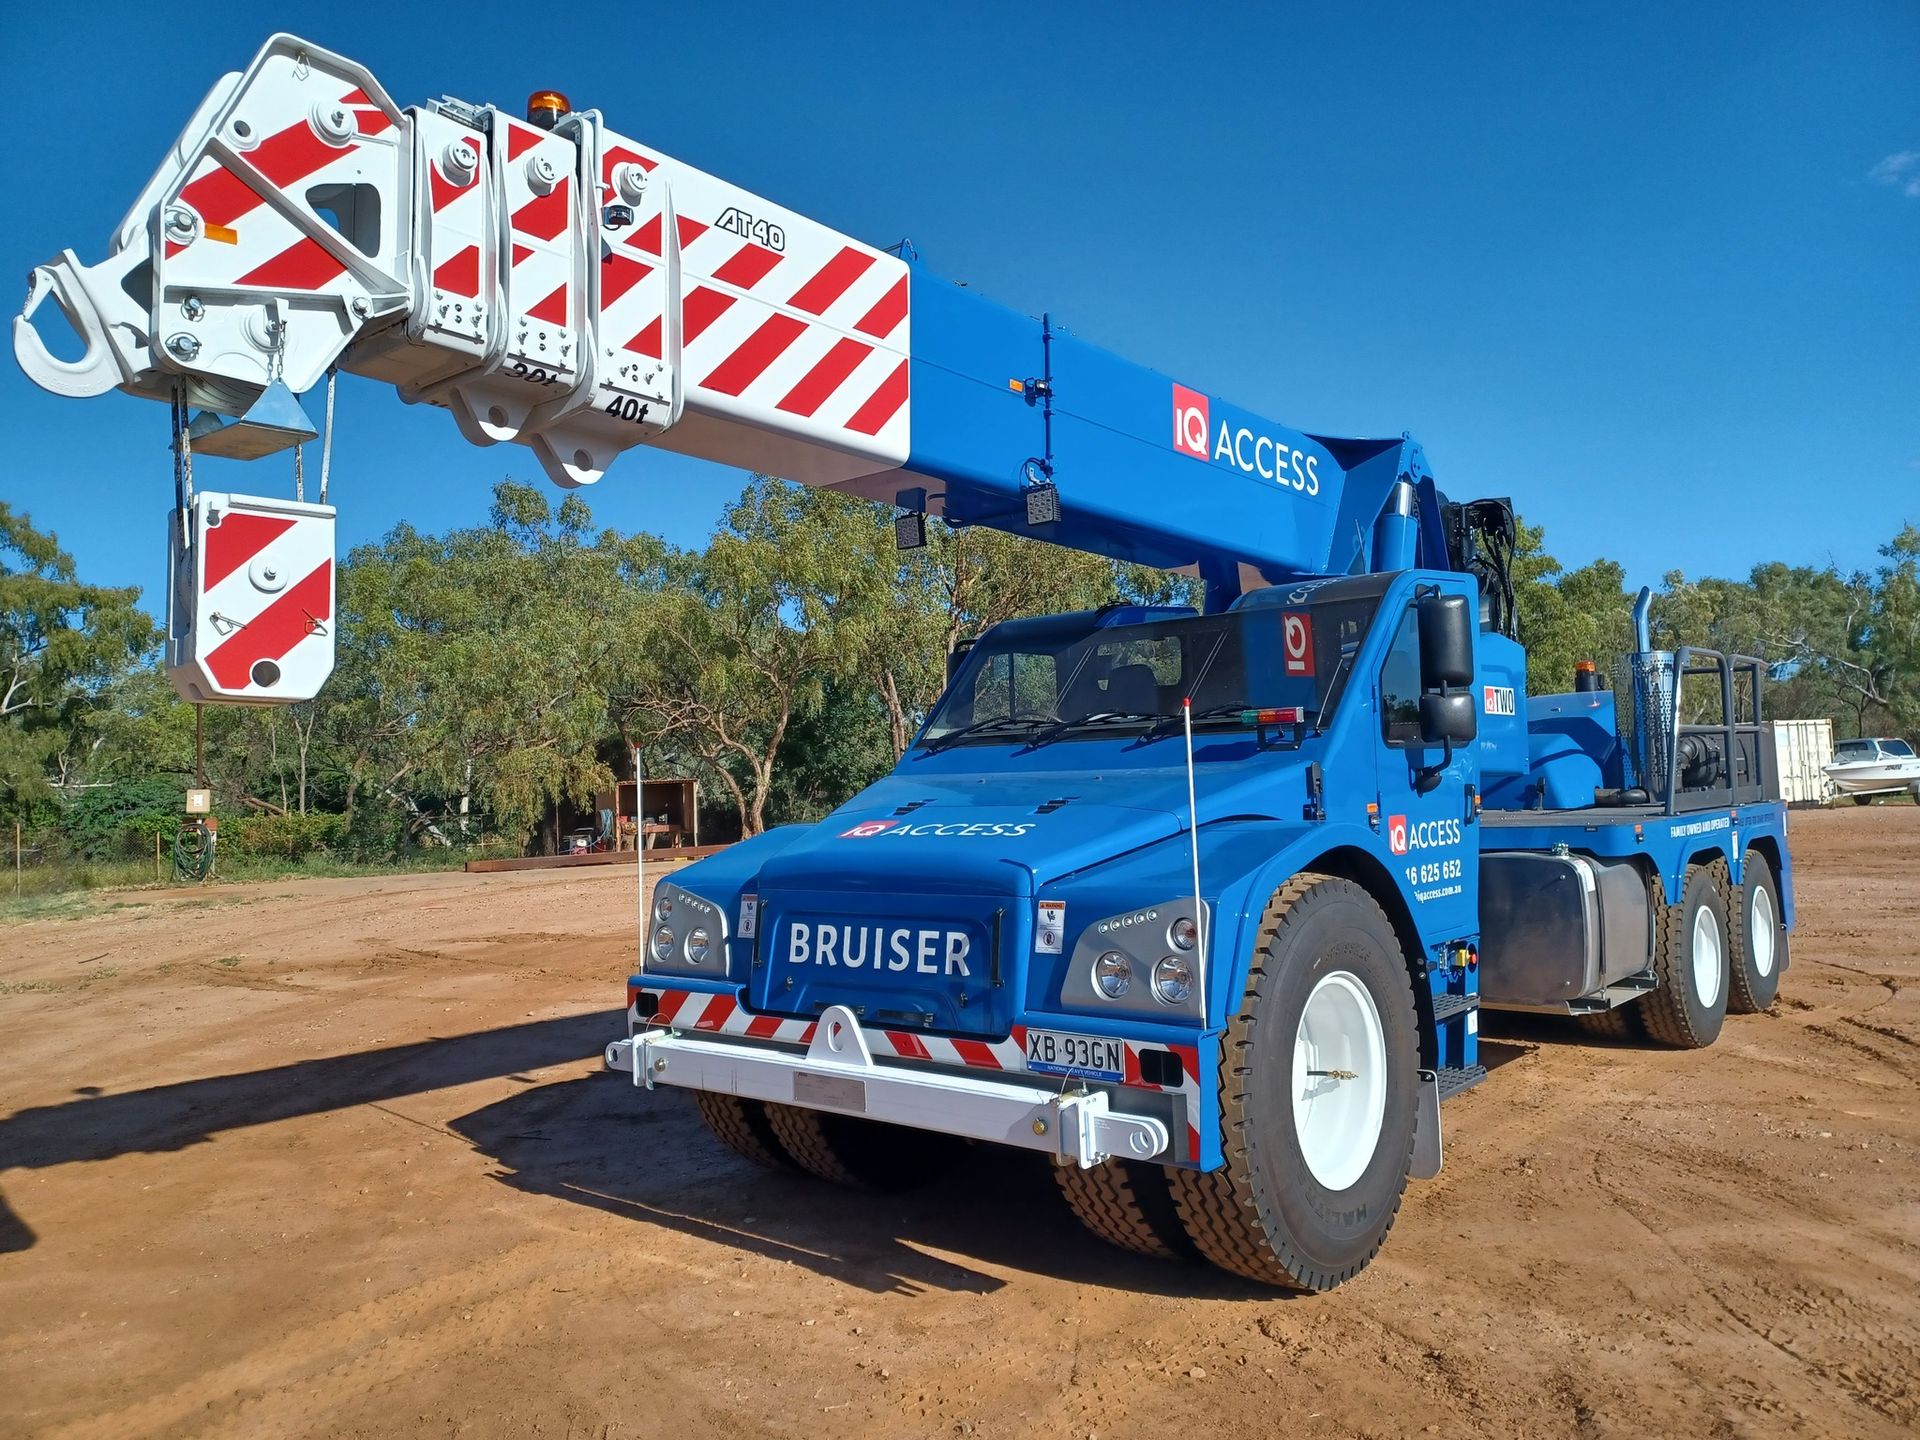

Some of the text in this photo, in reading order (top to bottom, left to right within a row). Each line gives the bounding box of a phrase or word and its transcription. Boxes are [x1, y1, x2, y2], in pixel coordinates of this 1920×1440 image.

[714, 206, 785, 252] AT40
[505, 362, 558, 387] 30t
[605, 395, 649, 424] 40t
[1176, 406, 1319, 496] IQ ACCESS
[1495, 689, 1514, 713] TWO
[840, 823, 1036, 837] IQ ACCESS
[1390, 818, 1460, 852] IQ ACCESS
[1671, 825, 1686, 838] FAMILY
[1687, 822, 1701, 836] OWNED
[1702, 820, 1710, 832] AND
[1421, 863, 1439, 883] 625
[1443, 859, 1461, 879] 652
[789, 922, 970, 977] BRUISER
[1047, 1065, 1067, 1073] NATIONAL
